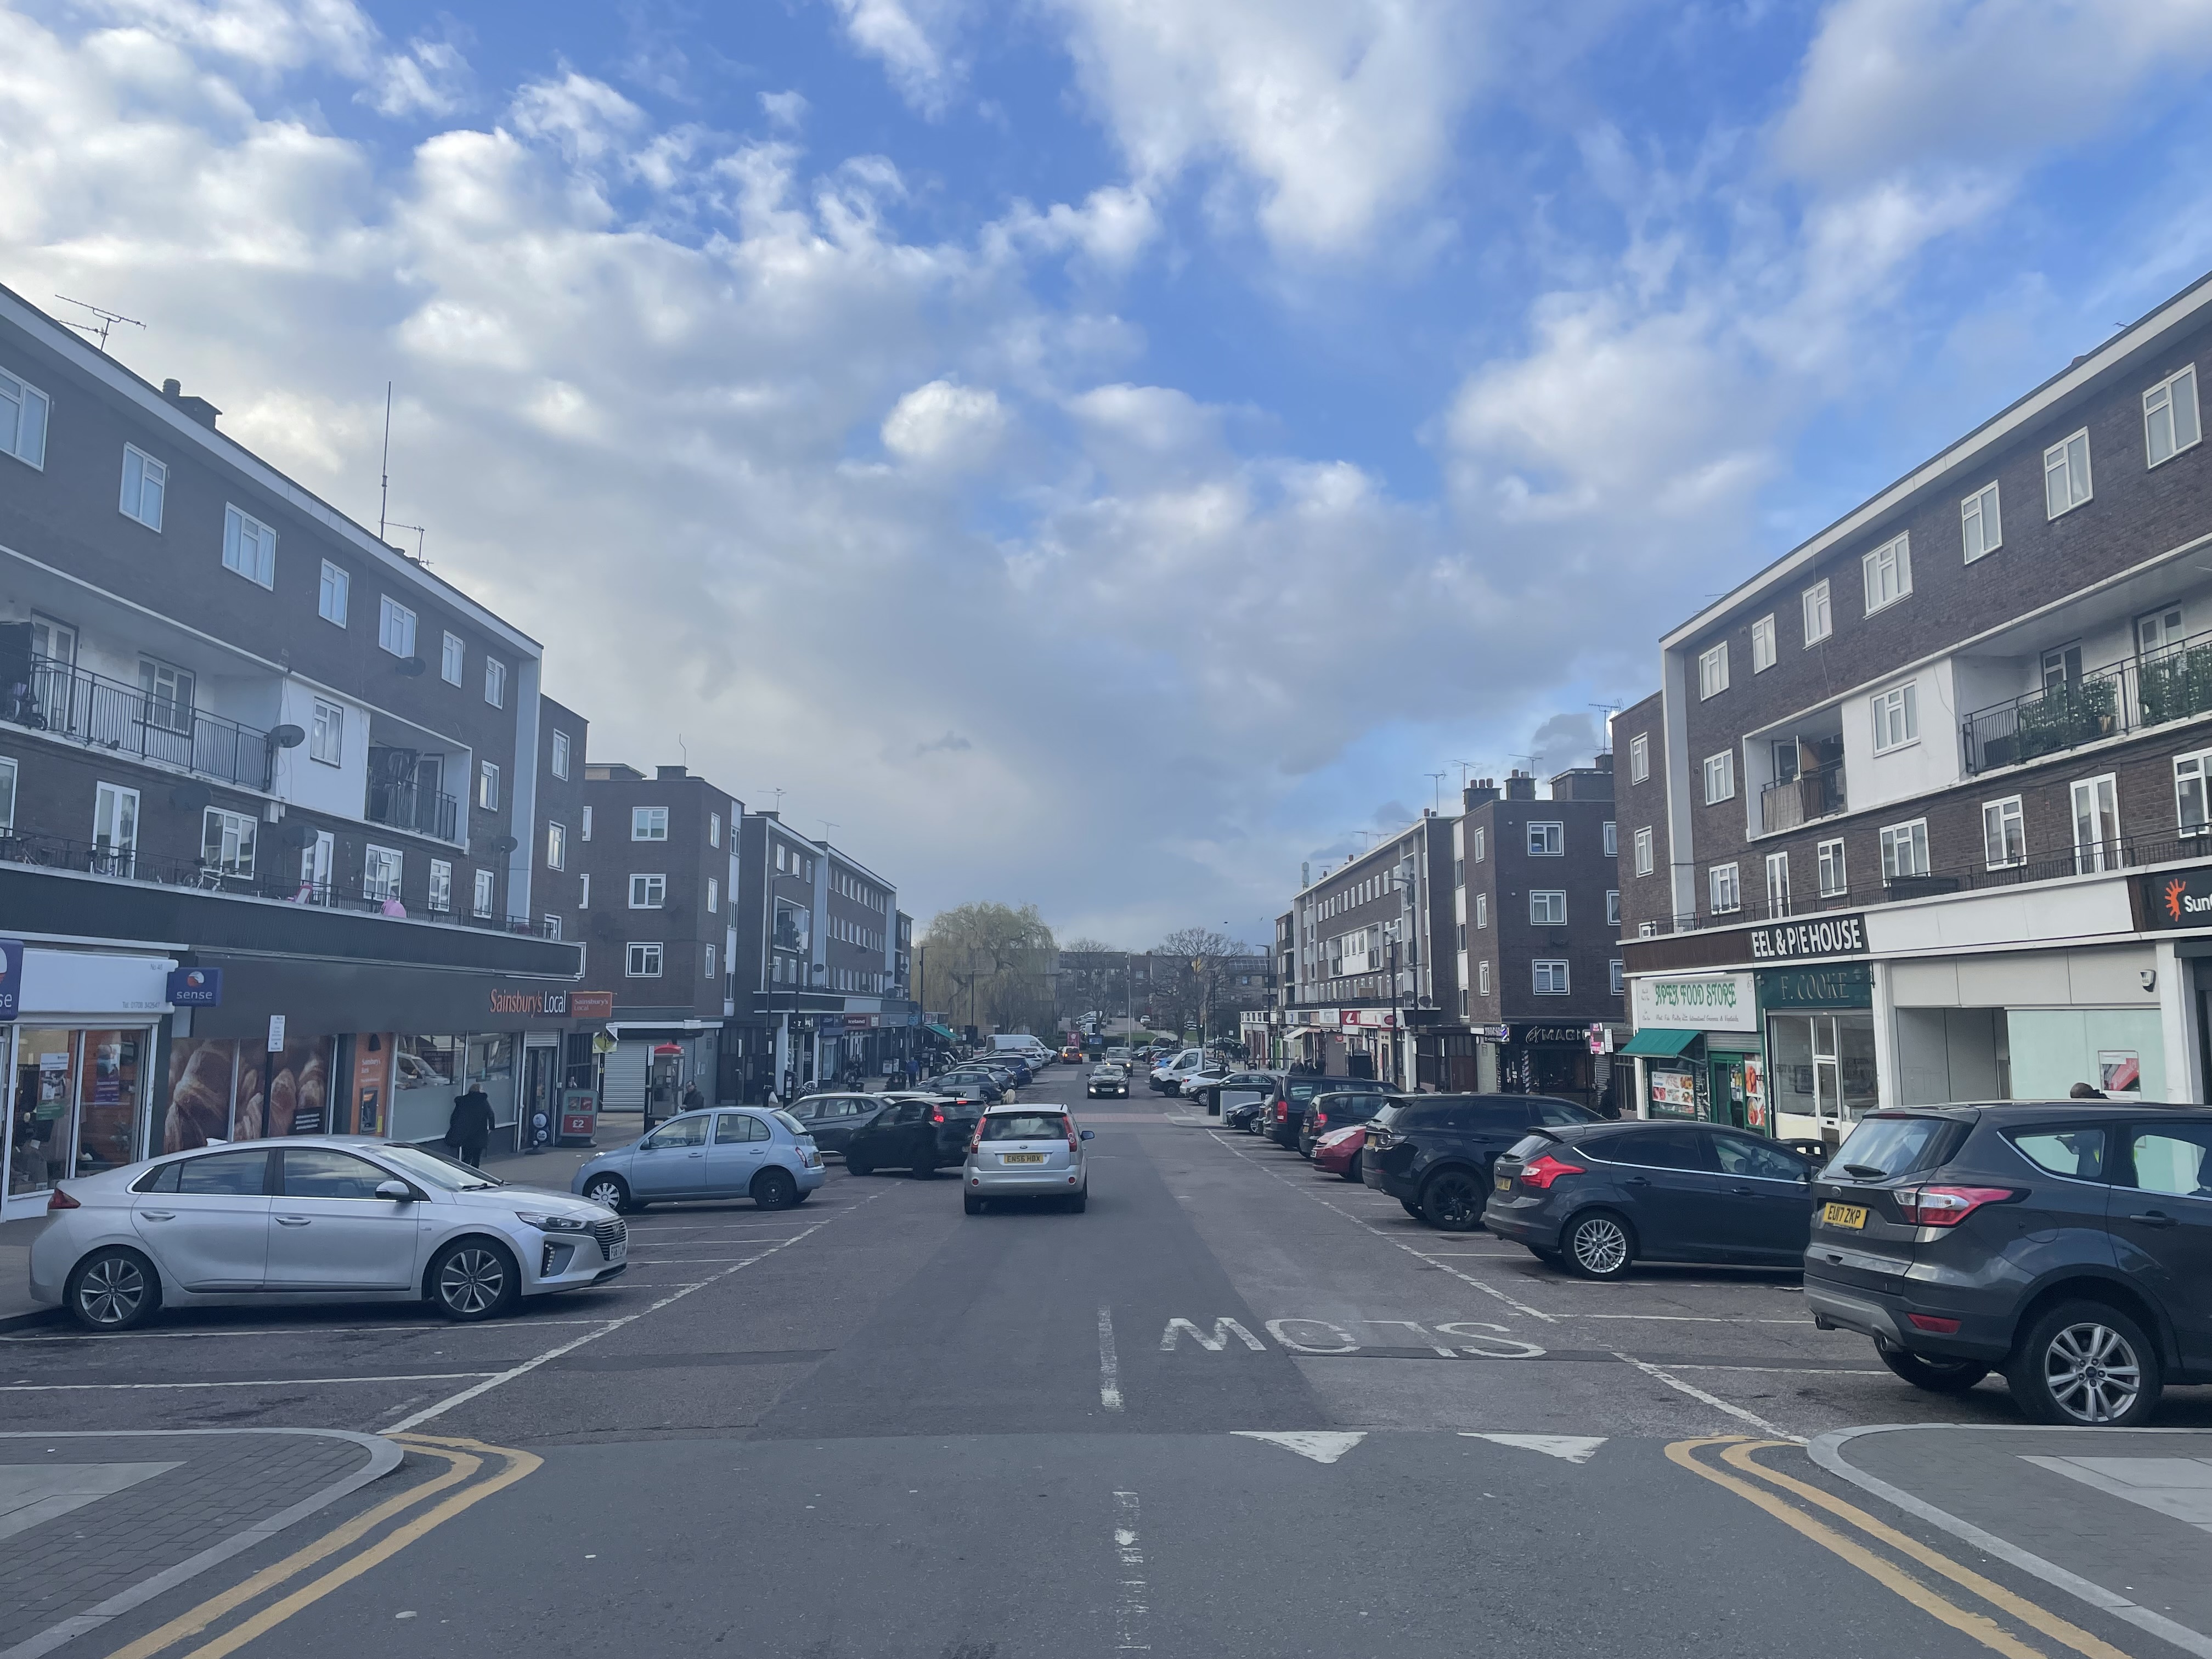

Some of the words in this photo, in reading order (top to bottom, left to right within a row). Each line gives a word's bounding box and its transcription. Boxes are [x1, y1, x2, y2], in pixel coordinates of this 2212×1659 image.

[1751, 930, 1775, 957] EEL
[1775, 928, 1787, 956] &
[1786, 926, 1810, 955] PIE
[1808, 918, 1863, 953] HOUSE
[176, 991, 212, 1000] sense
[1655, 984, 1679, 1006] APEX
[1680, 984, 1705, 1006] FOOD
[1707, 982, 1737, 1008] STORE
[1797, 972, 1850, 1001] COOKE
[489, 988, 542, 1018] Sainsbury's
[544, 990, 567, 1013] Local
[572, 1119, 584, 1128] £2
[1007, 1154, 1025, 1163] EN56
[1827, 1205, 1845, 1222] EU17
[1844, 1207, 1861, 1224] ZKP
[1160, 1316, 1548, 1359] SLOW
